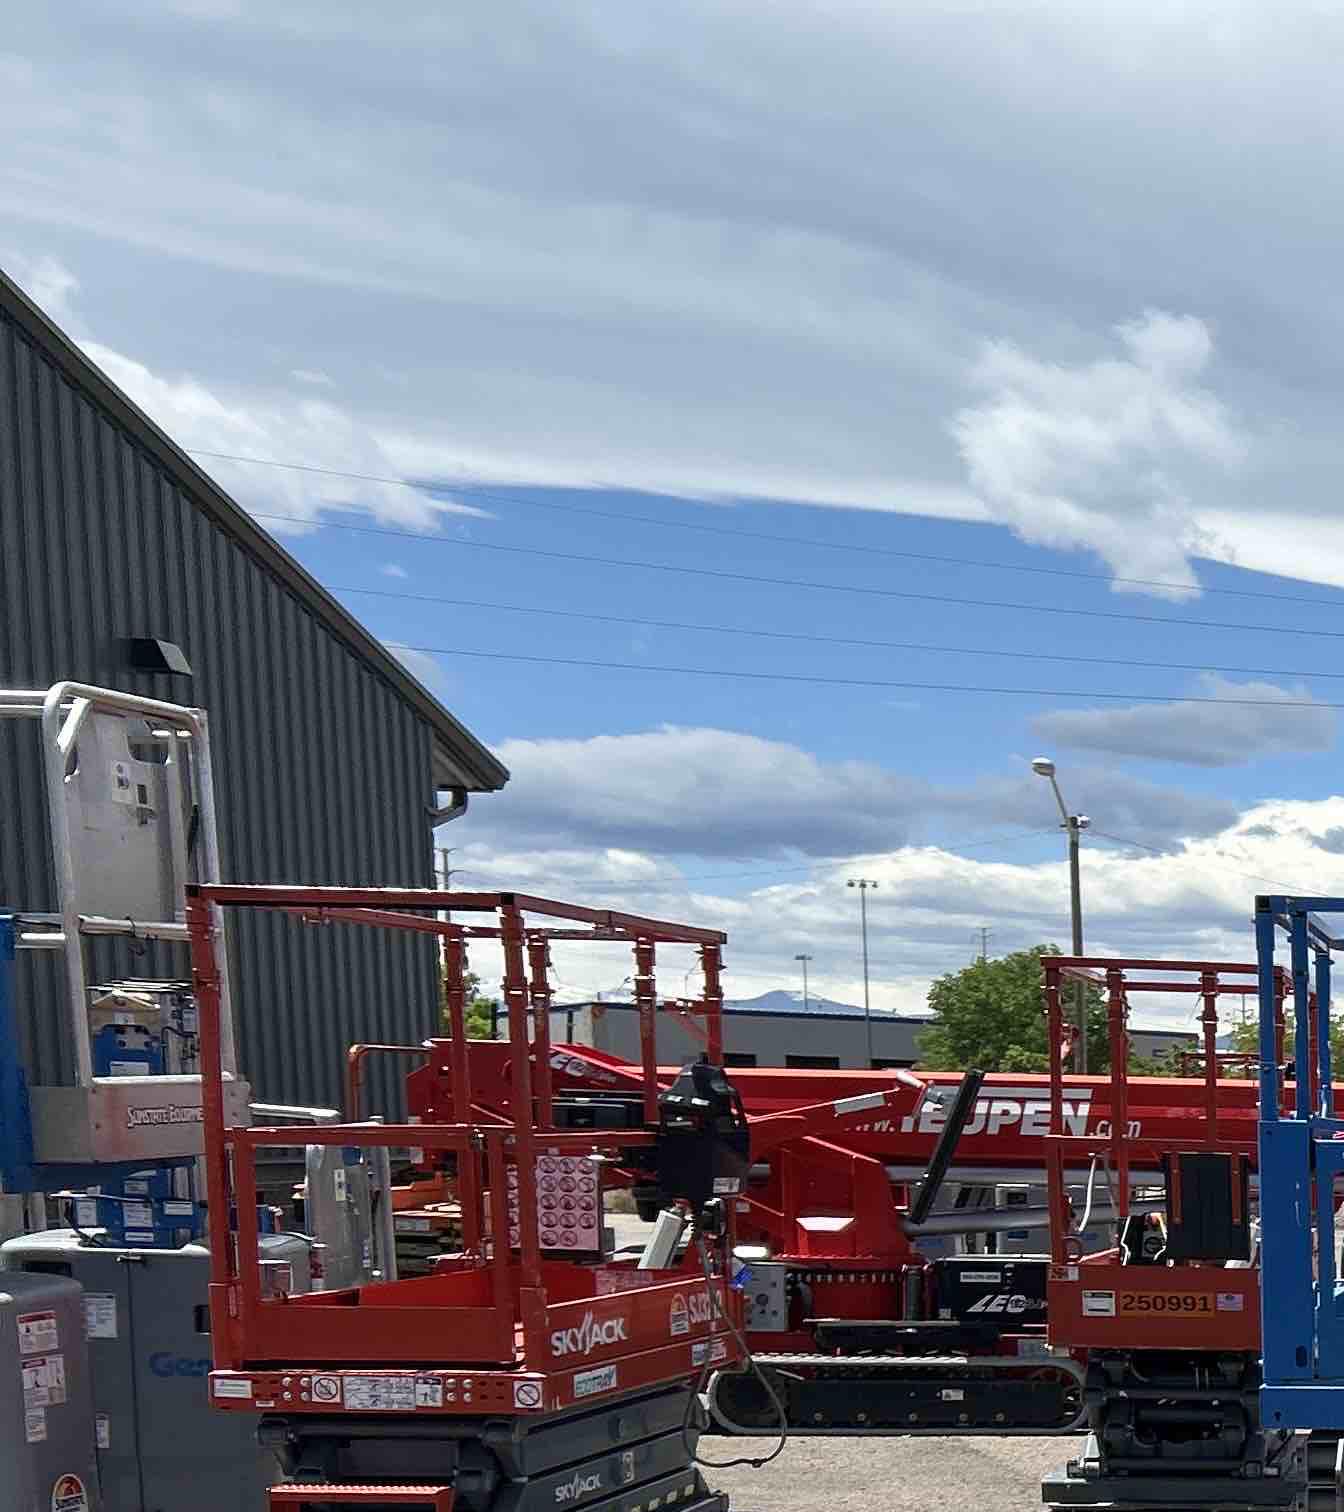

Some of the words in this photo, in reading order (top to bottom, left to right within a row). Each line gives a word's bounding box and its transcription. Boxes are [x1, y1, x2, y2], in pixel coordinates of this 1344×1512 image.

[1121, 1293, 1212, 1313] 250991
[550, 1312, 628, 1357] SKYJACK
[555, 1472, 601, 1502] SKYJACK
